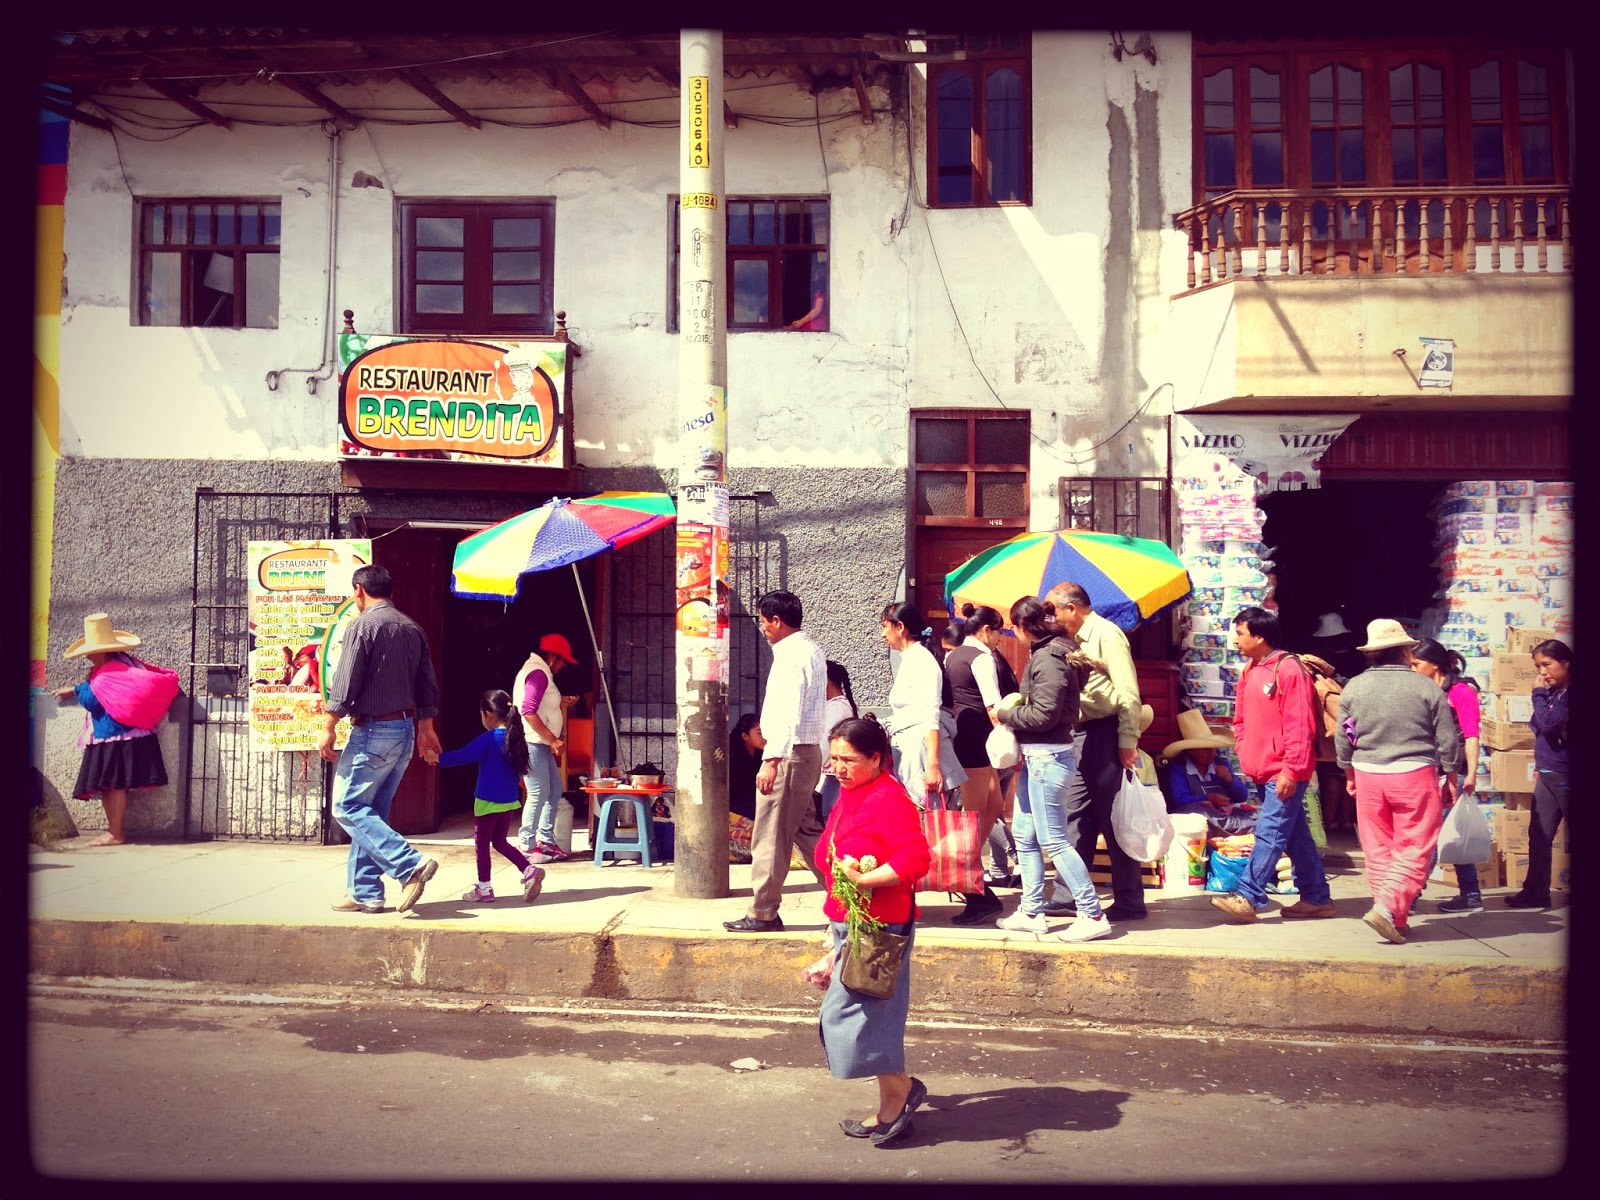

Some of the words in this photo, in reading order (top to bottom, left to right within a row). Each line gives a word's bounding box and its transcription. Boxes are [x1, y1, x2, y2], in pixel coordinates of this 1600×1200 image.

[693, 79, 702, 165] 3050640
[360, 367, 493, 393] RESTAURANT
[358, 397, 542, 443] BRENDITA
[1180, 434, 1245, 448] VIZZIO
[256, 595, 274, 603] POR
[277, 594, 293, 602] LAS
[256, 604, 283, 614] Caldo
[286, 604, 297, 613] de
[301, 604, 333, 614] gallina
[256, 616, 283, 624] Caldo
[286, 616, 297, 624] de
[256, 626, 283, 635] Caldo
[286, 626, 314, 634] verde
[256, 659, 284, 668] Leche
[256, 670, 284, 679] Jugos
[256, 722, 284, 731] Pollo
[299, 722, 309, 731] la
[268, 734, 318, 745] aguadito
